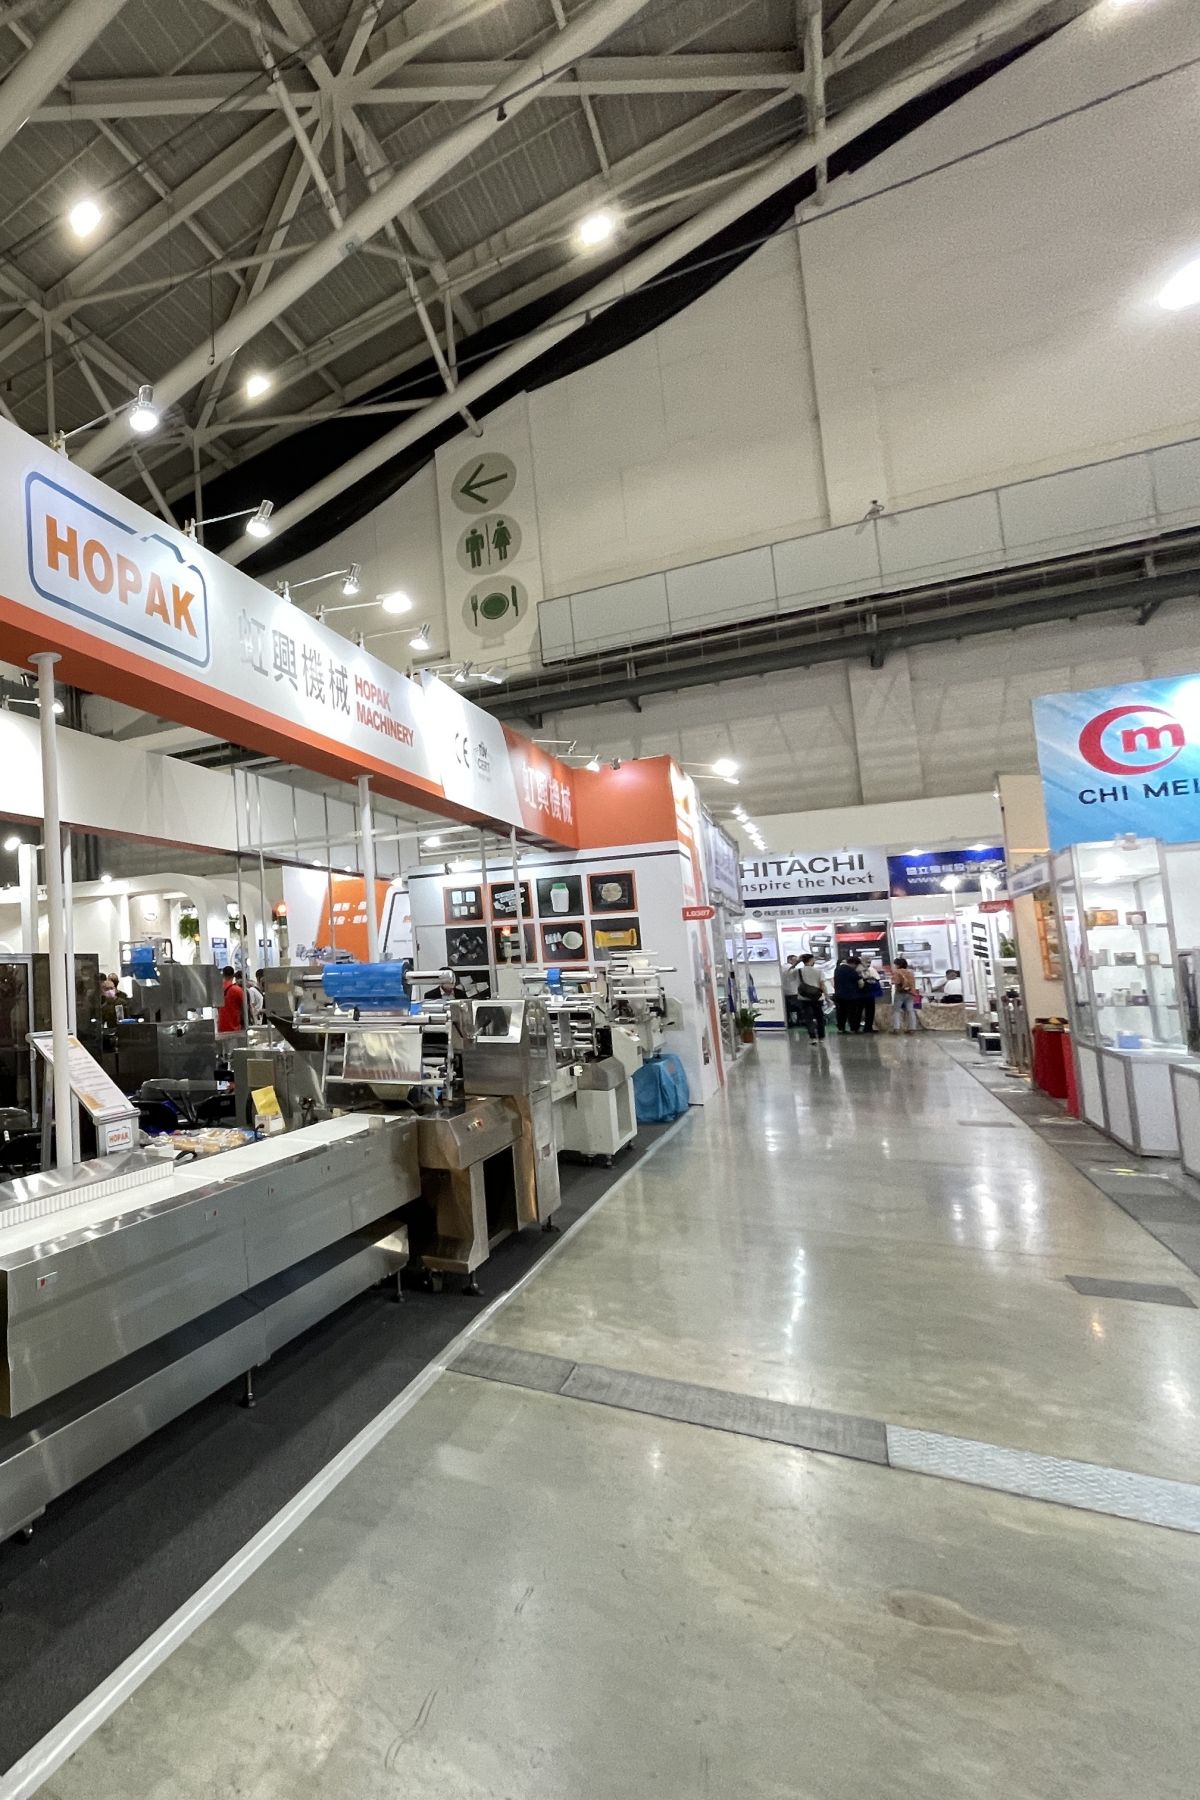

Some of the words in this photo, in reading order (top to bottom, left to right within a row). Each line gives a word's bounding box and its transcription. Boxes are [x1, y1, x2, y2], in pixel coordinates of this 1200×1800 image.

[45, 513, 198, 639] HOPAK
[239, 608, 350, 716] 虹興機械
[354, 674, 391, 712] HOPAK
[356, 701, 414, 747] MACHINERY
[1078, 786, 1129, 805] CHI
[740, 854, 865, 878] HITACHI
[741, 880, 791, 893] nspire
[798, 878, 825, 889] the
[832, 872, 875, 886] Next
